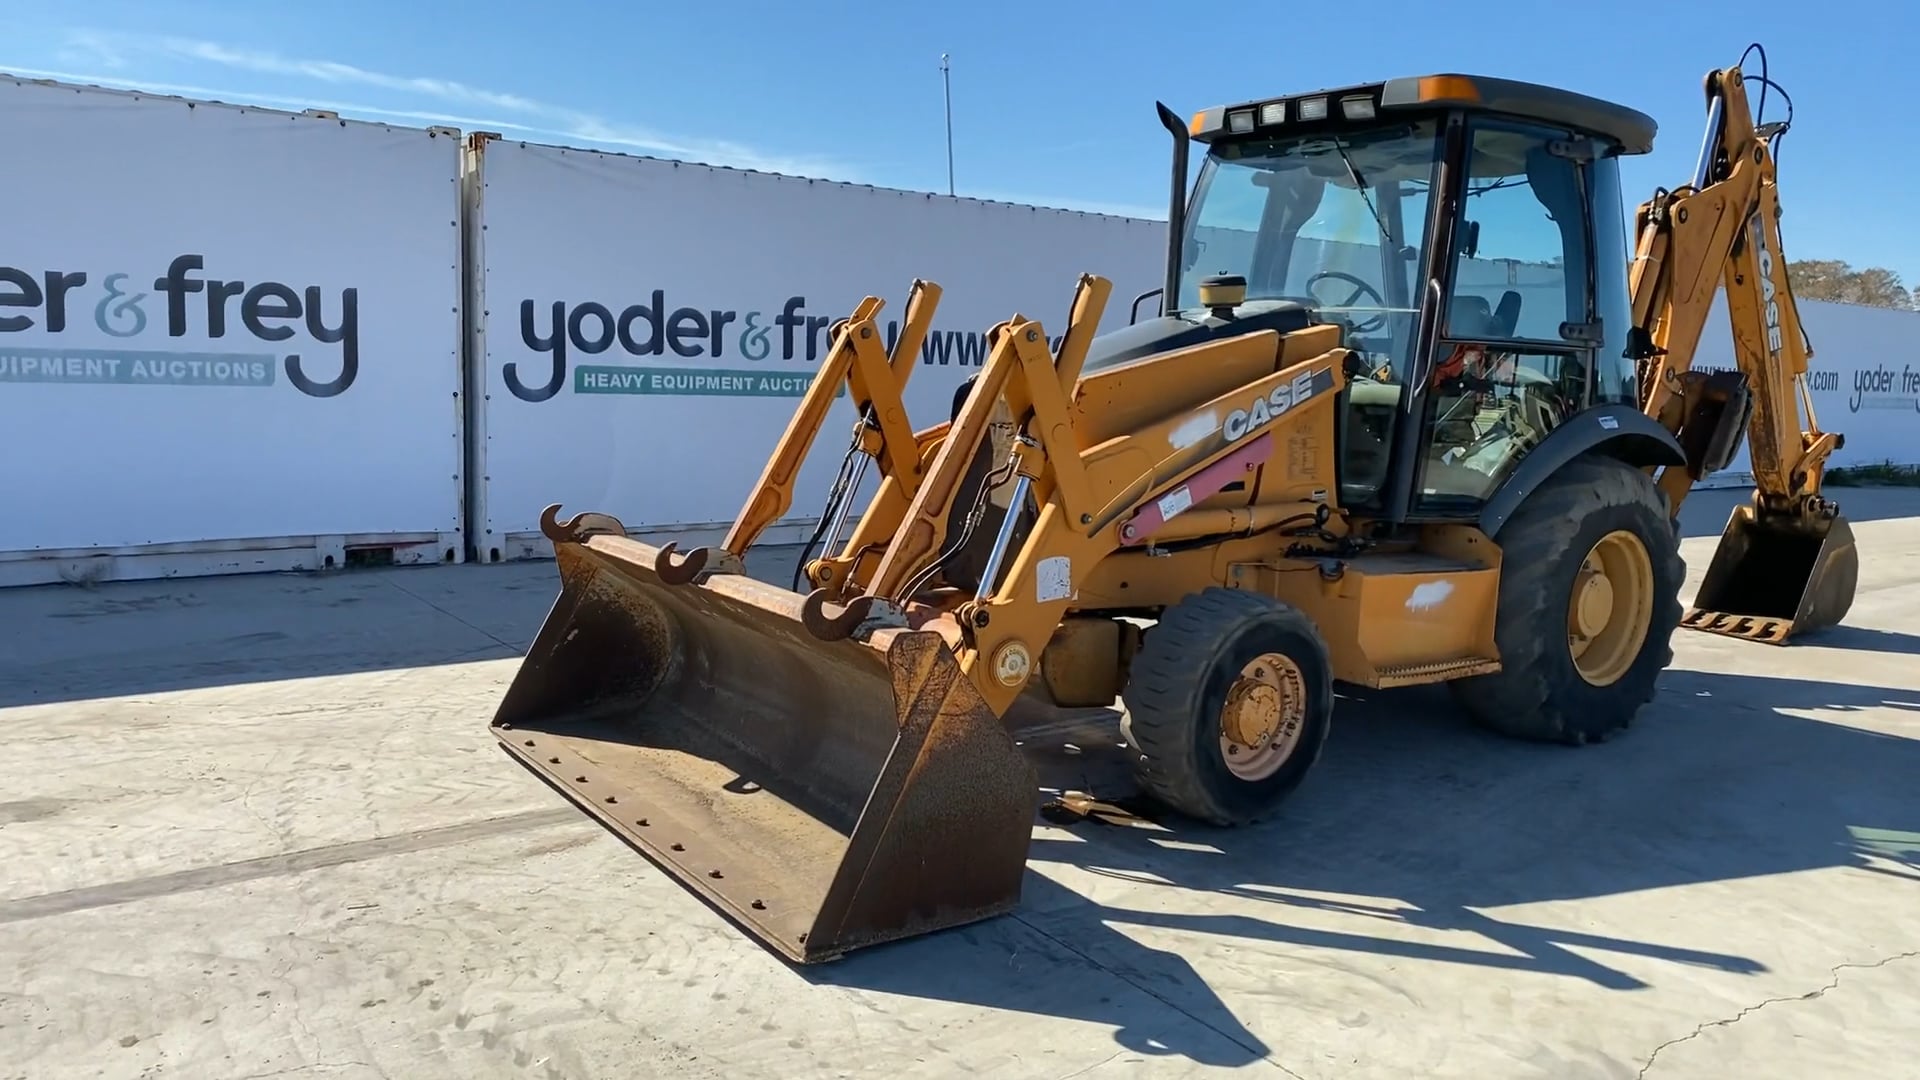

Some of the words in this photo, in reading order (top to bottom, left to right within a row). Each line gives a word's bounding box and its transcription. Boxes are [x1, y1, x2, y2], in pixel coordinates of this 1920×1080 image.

[94, 272, 147, 338] &
[154, 254, 358, 398] frey
[1758, 249, 1782, 352] CASE
[131, 359, 266, 380] AUCTIONS
[502, 289, 736, 403] yoder
[740, 311, 772, 361] &
[583, 373, 645, 389] HEAVY
[651, 375, 754, 391] EQUIPMENT
[759, 378, 811, 391] AUCTI
[1223, 369, 1313, 442] CASE
[1849, 363, 1895, 413] yoder
[1902, 364, 1920, 413] fre
